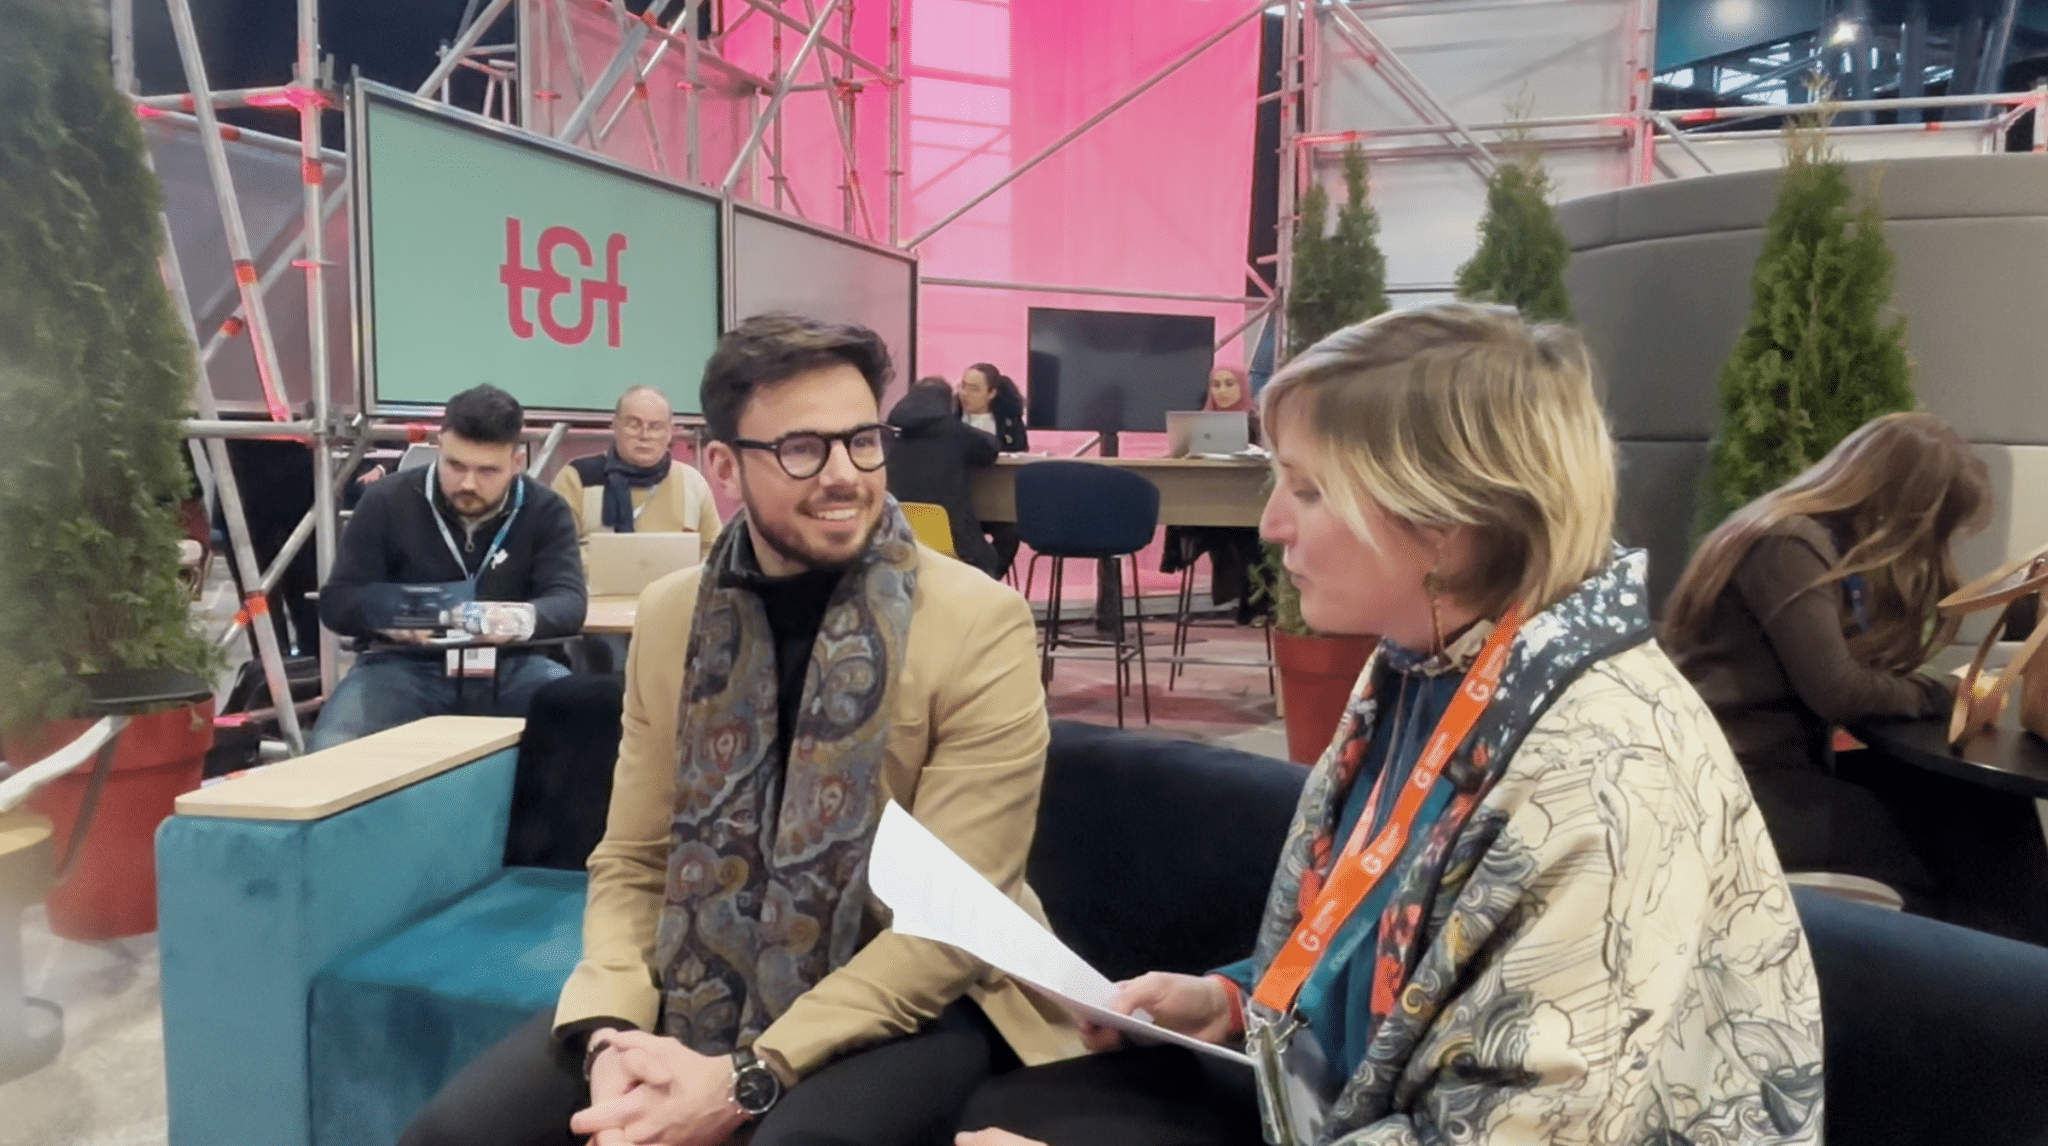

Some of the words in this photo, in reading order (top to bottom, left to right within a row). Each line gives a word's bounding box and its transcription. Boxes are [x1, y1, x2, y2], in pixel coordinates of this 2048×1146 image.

[1465, 679, 1490, 702] G
[1413, 767, 1432, 790] G
[1360, 853, 1383, 875] G
[1299, 928, 1321, 952] G
